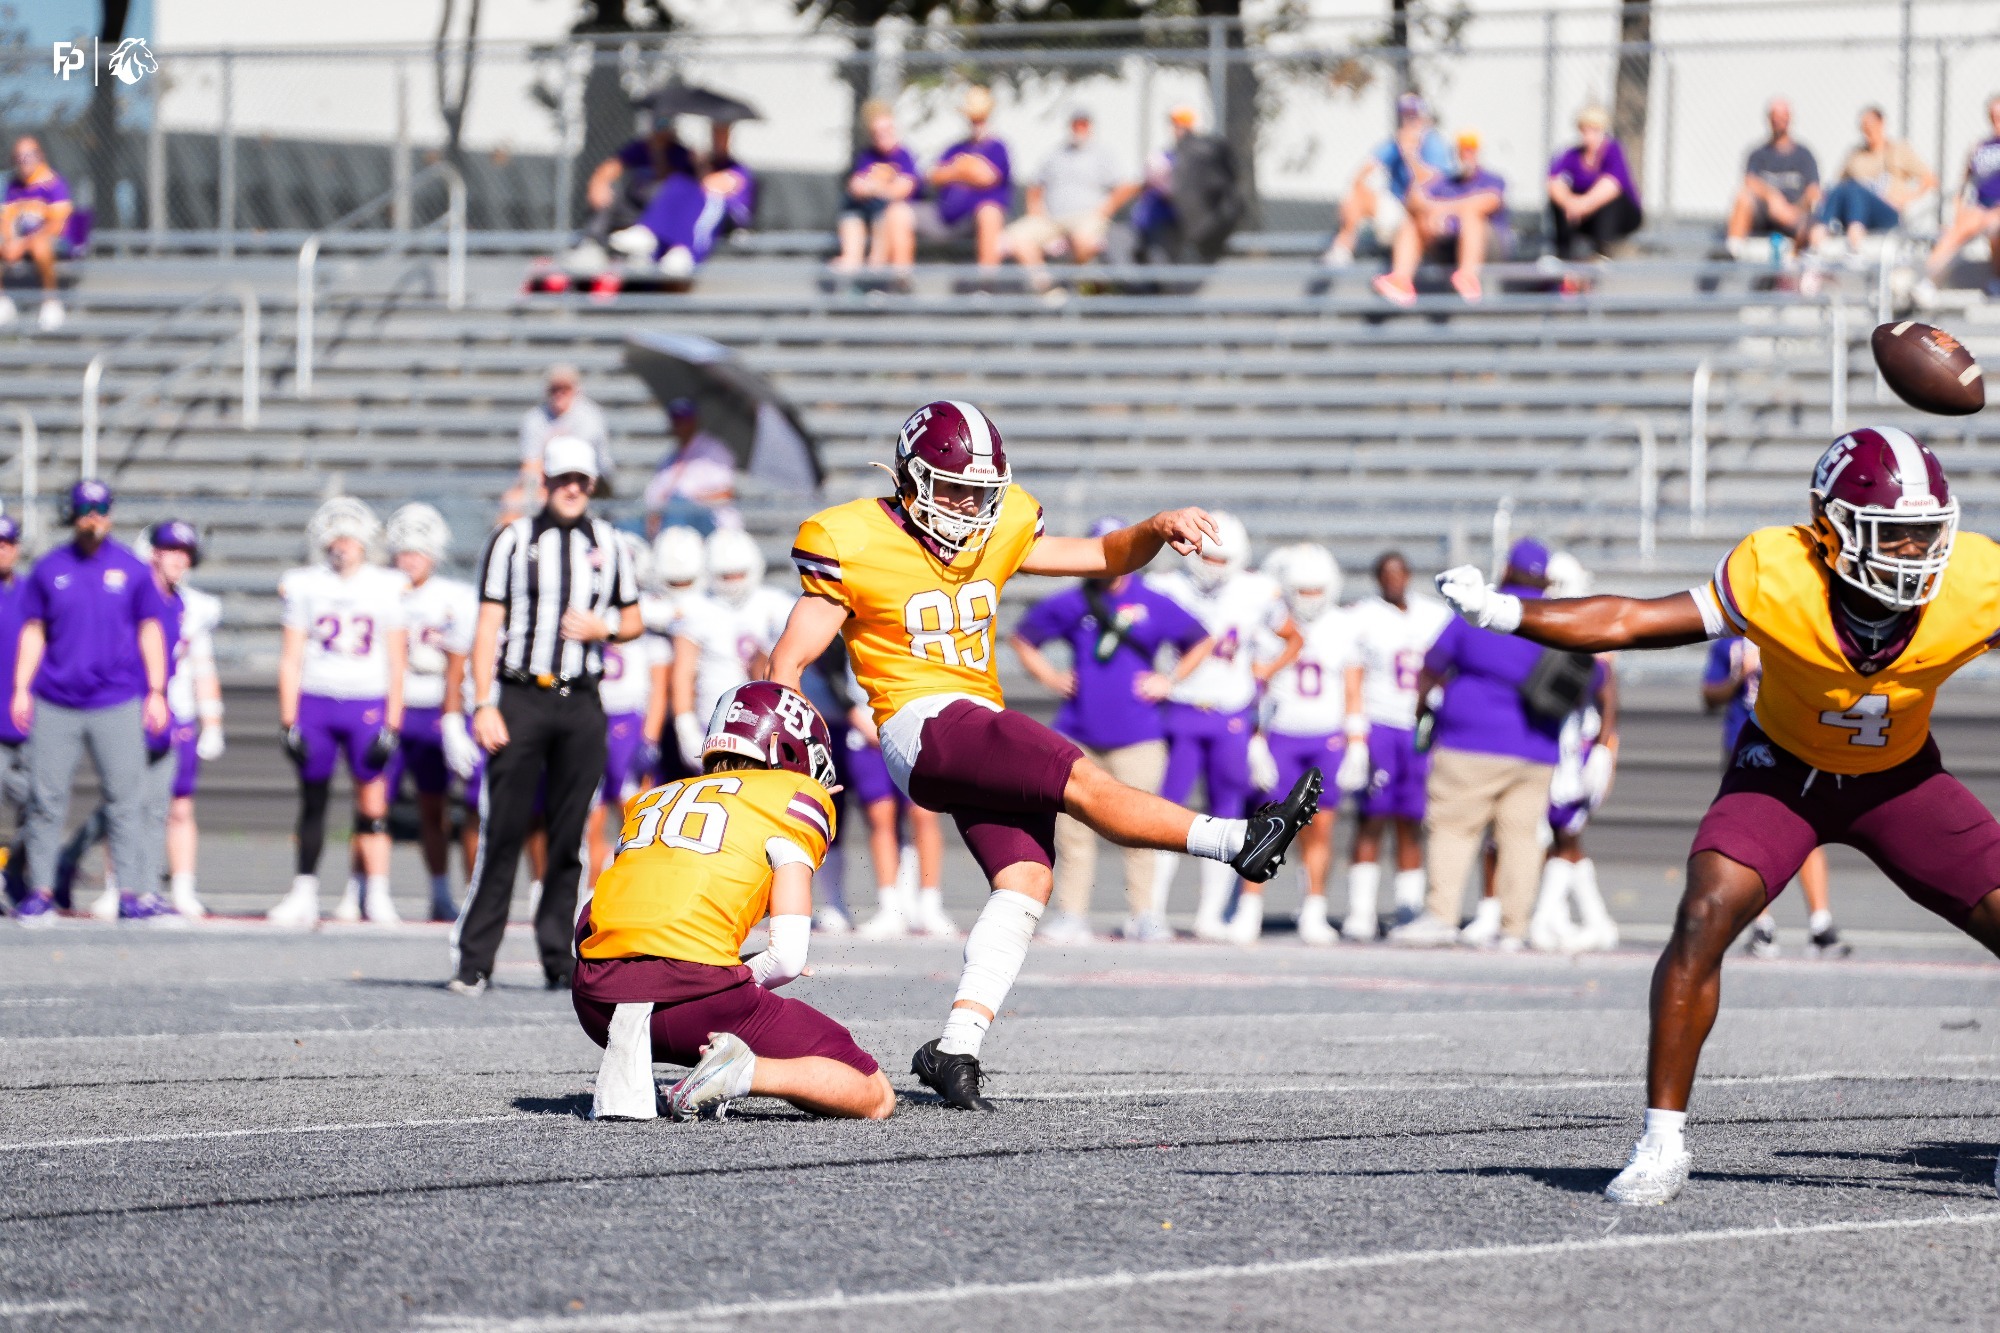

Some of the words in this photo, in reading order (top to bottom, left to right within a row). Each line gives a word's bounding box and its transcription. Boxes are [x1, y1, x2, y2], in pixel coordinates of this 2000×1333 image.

[315, 614, 374, 656] 23
[903, 577, 997, 673] 89
[1818, 692, 1893, 748] 4
[613, 776, 743, 856] 36
